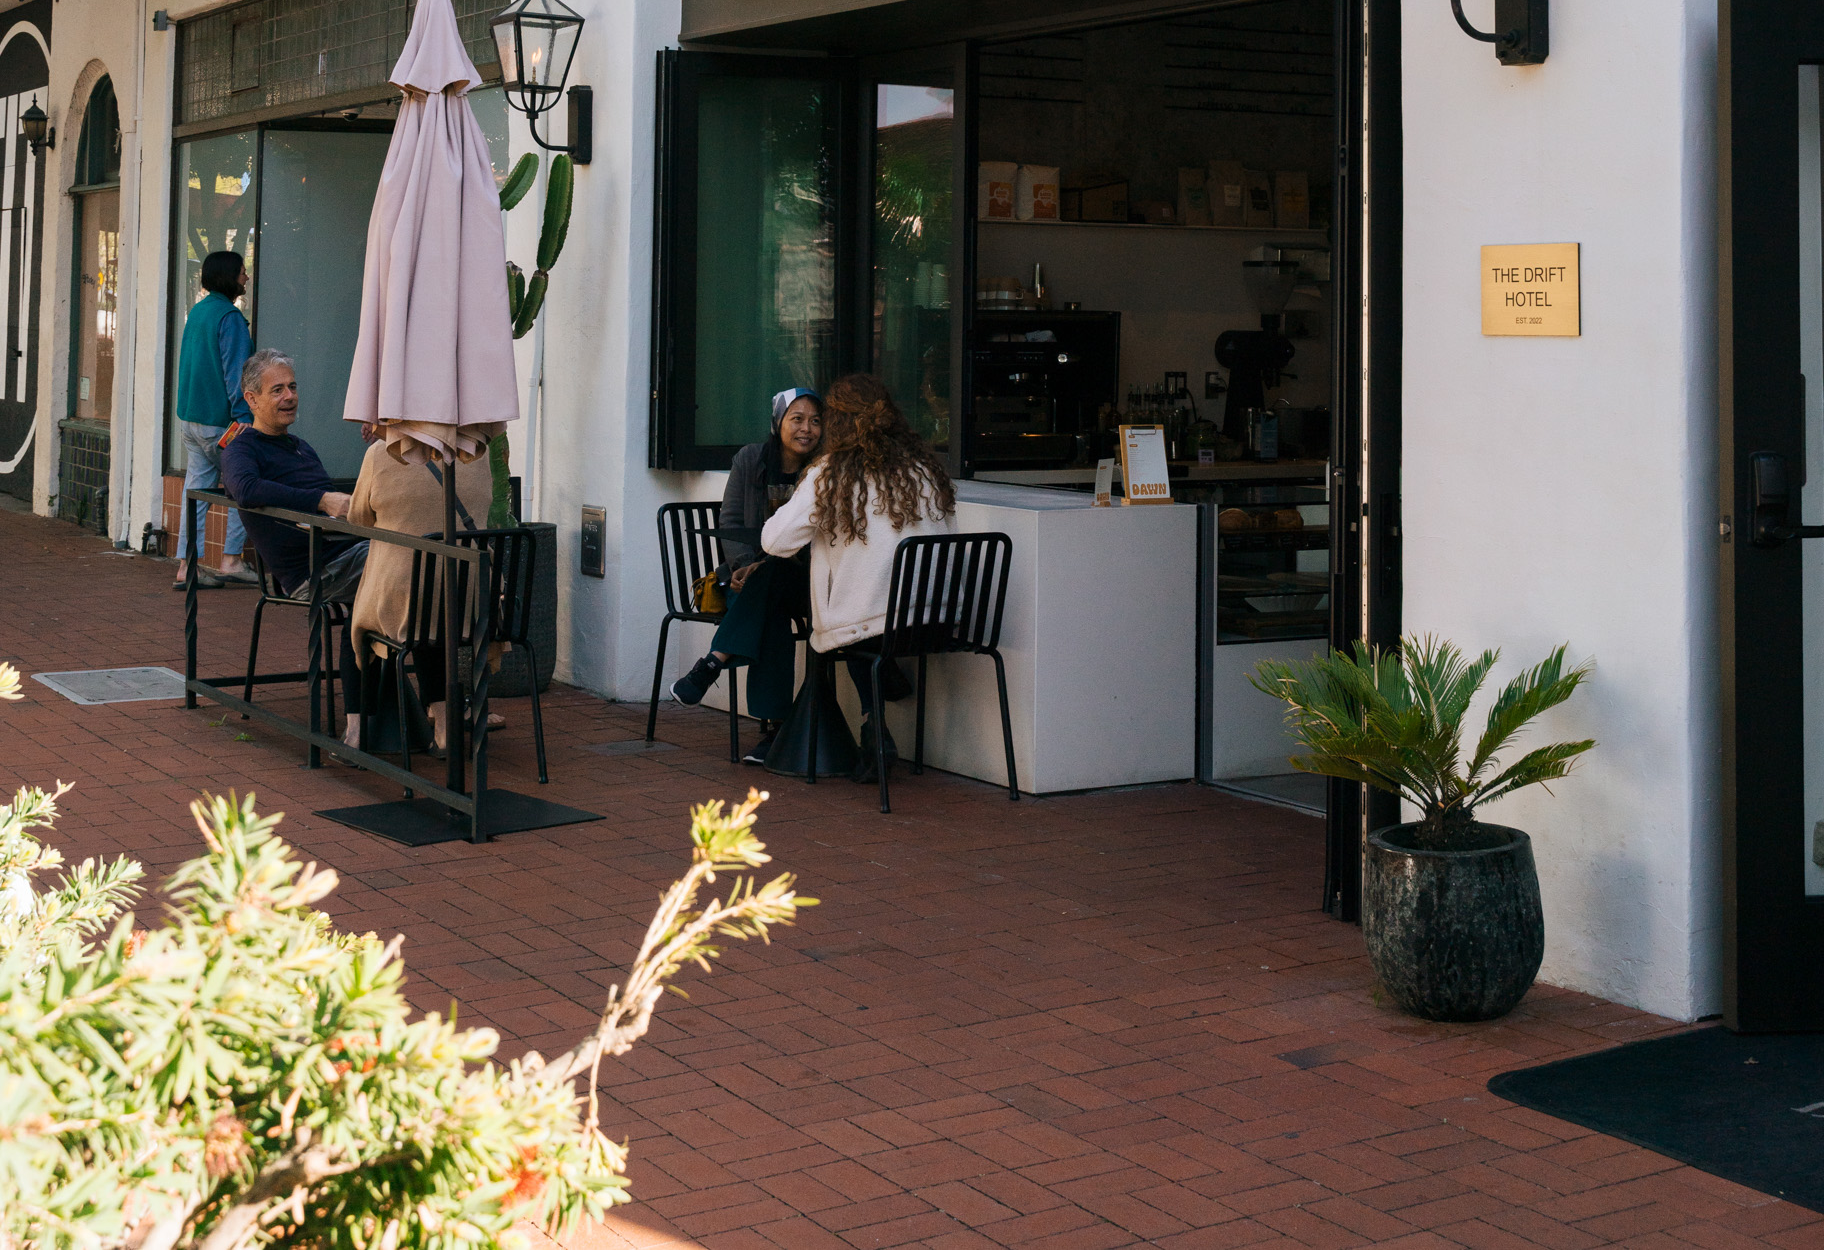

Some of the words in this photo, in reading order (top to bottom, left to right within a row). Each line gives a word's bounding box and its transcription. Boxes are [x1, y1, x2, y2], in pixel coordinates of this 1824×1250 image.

[1491, 267, 1519, 282] THE
[1524, 266, 1565, 282] DRIFT
[1505, 291, 1552, 307] HOTEL
[1132, 483, 1167, 496] DAWN
